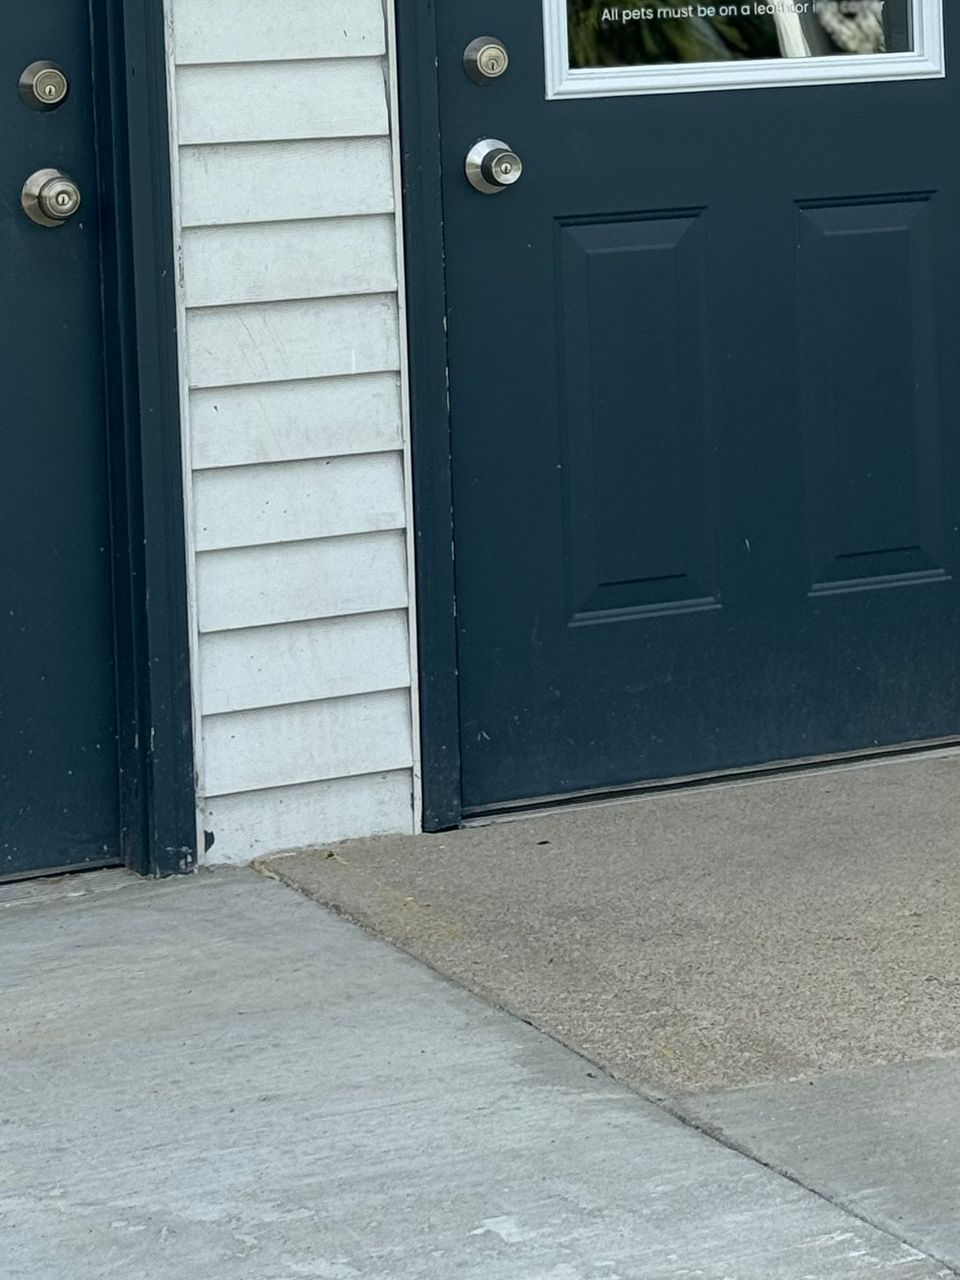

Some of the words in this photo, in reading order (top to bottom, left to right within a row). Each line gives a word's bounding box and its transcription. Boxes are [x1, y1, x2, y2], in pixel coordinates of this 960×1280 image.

[601, 7, 618, 21] All
[622, 8, 653, 24] pets
[657, 6, 693, 19] must
[697, 4, 715, 17] be
[719, 5, 737, 17] on
[741, 4, 750, 15] a
[795, 2, 809, 14] or
